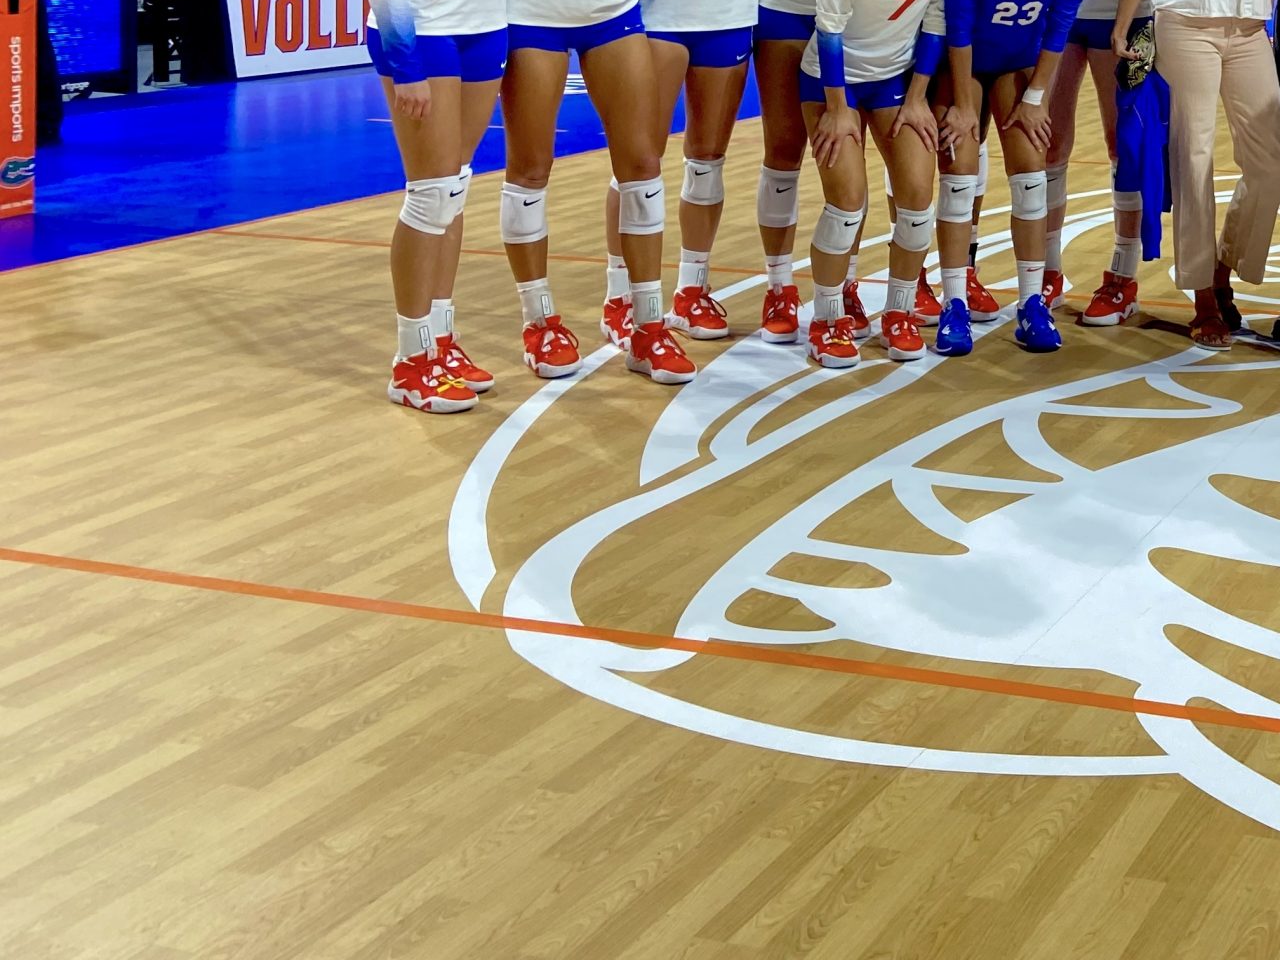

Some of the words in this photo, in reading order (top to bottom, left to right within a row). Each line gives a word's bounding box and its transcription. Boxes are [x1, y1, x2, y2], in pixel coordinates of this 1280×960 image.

[991, 0, 1043, 27] 23
[9, 36, 23, 83] sports
[9, 85, 24, 142] imports
